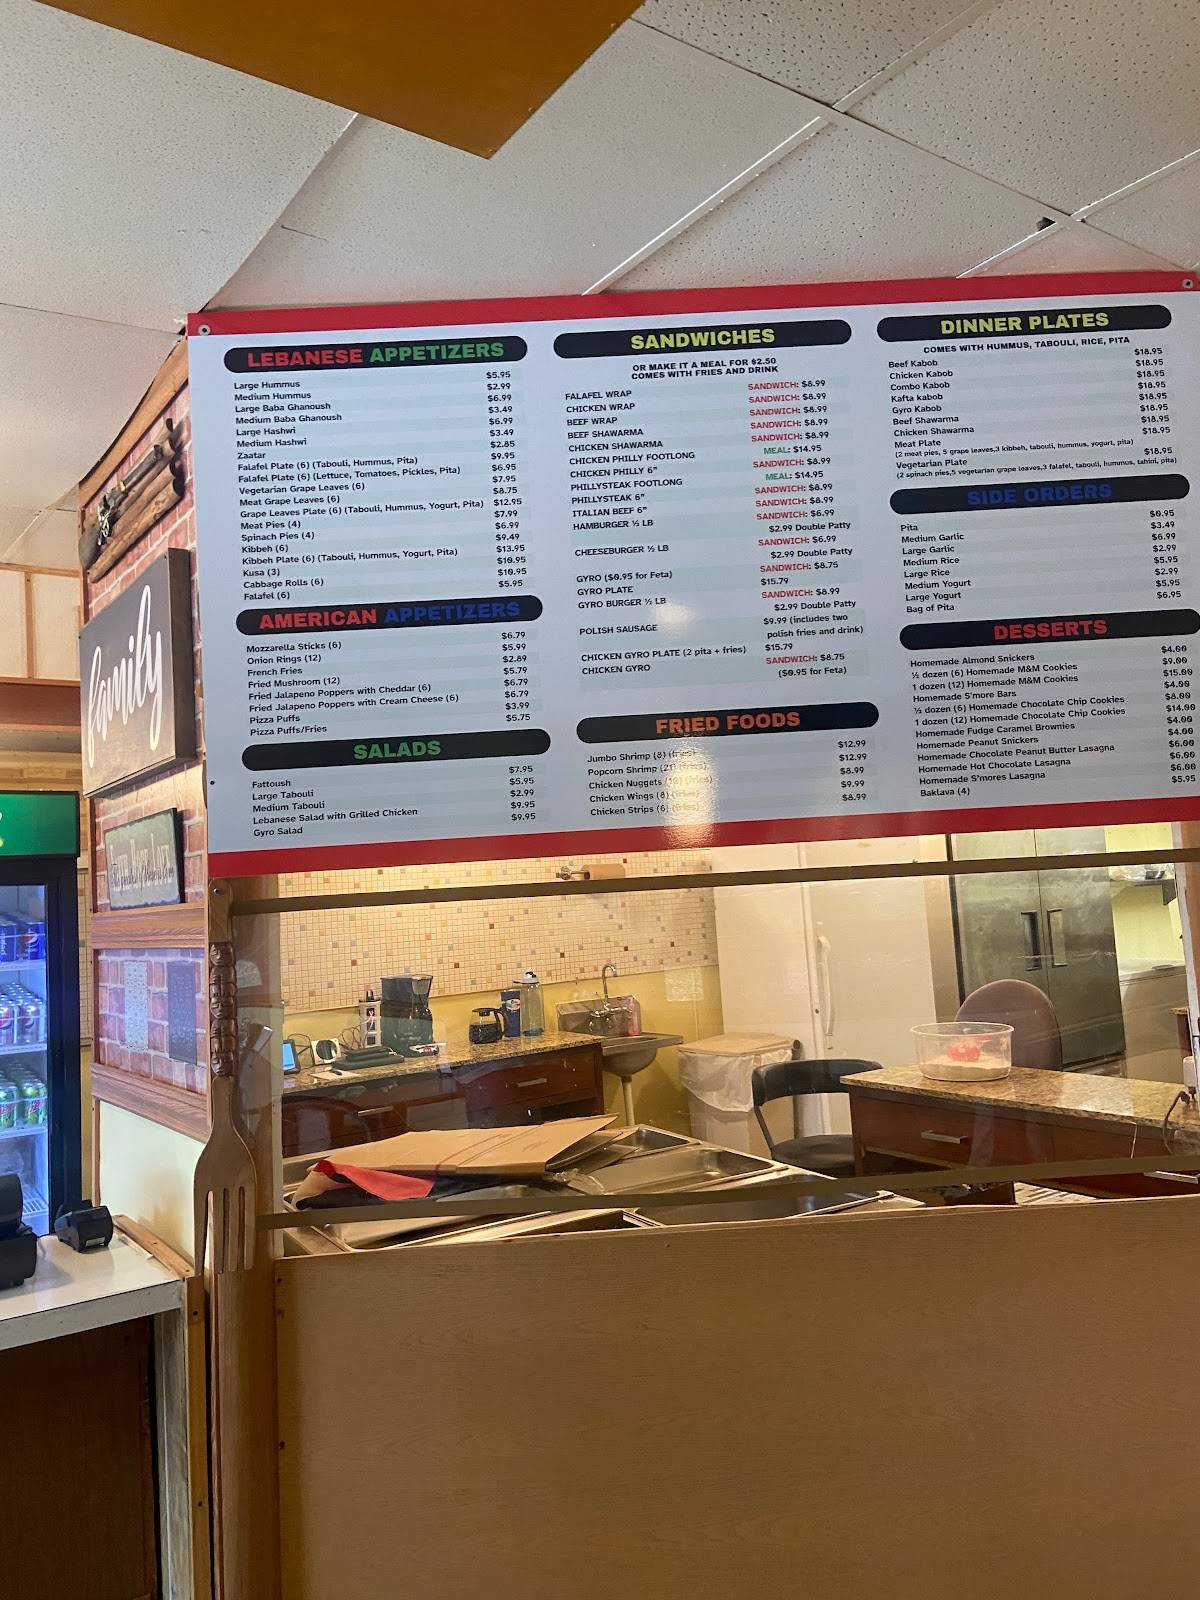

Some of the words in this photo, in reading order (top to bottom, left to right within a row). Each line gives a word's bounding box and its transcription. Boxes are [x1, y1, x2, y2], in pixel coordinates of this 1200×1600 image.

[940, 316, 1023, 334] DINNER
[1028, 311, 1109, 330] PLATES
[630, 328, 775, 350] SANDWICHES
[922, 344, 958, 355] COMES
[957, 343, 985, 352] WITH
[985, 340, 1033, 351] HUMMUS,
[1033, 337, 1079, 349] TABOULI,
[1079, 336, 1107, 346] RICE,
[1107, 335, 1131, 345] PITA
[246, 347, 363, 368] LEBANESE
[369, 341, 504, 362] APPETIZERS
[1132, 346, 1164, 357] $18.95
[631, 363, 647, 373] OR
[647, 361, 677, 372] MAKE
[677, 360, 689, 370] IT
[689, 360, 699, 369] A
[699, 359, 728, 369] MEAL
[727, 357, 749, 367] FOR
[749, 356, 777, 366] $2.50
[887, 358, 909, 369] Beef
[909, 358, 939, 368] Kabob
[484, 369, 512, 380] $5.95
[630, 370, 666, 381] COMES
[666, 369, 693, 379] WITH
[693, 367, 724, 377] FRIES
[723, 366, 746, 376] AND
[746, 364, 779, 374] DRINK
[232, 381, 260, 392] Large
[260, 380, 302, 389] Hummus
[746, 380, 800, 391] SANDWICH:
[563, 390, 604, 401] FALAFEL
[604, 388, 633, 399] WRAP
[486, 404, 513, 415] $3.49
[748, 406, 802, 417] SANDWICH:
[234, 414, 272, 425] Medium
[272, 414, 297, 424] Baba
[297, 412, 343, 423] Ghanoush
[565, 417, 590, 427] BEEF
[589, 415, 619, 426] WRAP
[749, 418, 803, 430] SANDWICH:
[1139, 413, 1170, 424] $18.95
[566, 430, 590, 440] BEEF
[590, 427, 645, 439] SHAWARMA
[892, 427, 929, 438] Chicken
[928, 425, 976, 436] Shawarma
[488, 439, 516, 450] $2.85
[762, 445, 791, 455] MEAL:
[791, 443, 823, 454] $14.95
[1142, 445, 1174, 457] $18.95
[235, 450, 267, 461] Zaatar
[489, 450, 516, 461] $9.95
[567, 454, 611, 466] CHICKEN
[610, 453, 644, 464] PHILLY
[645, 450, 696, 462] FOOTLONG
[236, 461, 269, 472] Falafel
[269, 461, 295, 471] Plate
[295, 460, 311, 471] (6)
[310, 457, 352, 470] (Tabouli,
[351, 458, 395, 467] Hummus,
[395, 455, 419, 466] Pita)
[894, 458, 943, 471] Vegetarian
[943, 457, 969, 467] Plate
[966, 488, 1016, 505] SIDE
[1023, 483, 1112, 502] ORDERS
[492, 508, 519, 519] $7.99
[239, 521, 264, 531] Meat
[264, 519, 286, 530] Pies
[286, 519, 302, 530] (4)
[493, 520, 520, 531] $6.99
[1149, 519, 1176, 531] $3.49
[239, 531, 278, 544] Spinach
[278, 530, 300, 541] Pies
[300, 530, 316, 541] (4)
[494, 531, 521, 542] $9.49
[900, 533, 937, 544] Medium
[937, 531, 965, 542] Garlic
[240, 543, 274, 554] Kibbeh
[273, 542, 289, 554] (6)
[496, 566, 528, 577] $10.95
[241, 579, 284, 590] Cabbage
[283, 577, 309, 588] Rolls
[309, 576, 325, 588] (6)
[759, 575, 790, 587] $15.79
[575, 586, 604, 597] GYRO
[603, 584, 634, 595] PLATE
[1155, 589, 1183, 600] $6.95
[905, 604, 924, 615] Bag
[924, 602, 935, 613] of
[935, 601, 956, 612] Pita
[258, 608, 377, 630] AMERICAN
[384, 601, 519, 622] APPETIZERS
[761, 615, 788, 626] $9.99
[788, 613, 831, 626] (includes
[830, 613, 849, 622] two
[500, 630, 527, 641] $6.79
[578, 625, 615, 636] POLISH
[614, 623, 658, 634] SAUSAGE
[765, 628, 795, 640] polish
[794, 626, 817, 637] fries
[817, 626, 836, 636] and
[835, 624, 864, 635] drink)
[993, 619, 1107, 640] DESSERTS
[244, 642, 296, 654] Mozzarella
[296, 640, 327, 651] Sticks
[327, 640, 342, 651] (6)
[500, 641, 527, 653] $5.99
[245, 654, 275, 666] Onion
[274, 653, 303, 665] Rings
[302, 652, 322, 664] (12)
[501, 653, 528, 664] $2.89
[909, 656, 960, 668] Homemade
[960, 654, 996, 665] Almond
[996, 652, 1036, 663] Snickers
[87, 584, 163, 769] family
[246, 667, 279, 678] French
[278, 665, 304, 676] Fries
[911, 682, 917, 692] 1
[917, 681, 946, 691] dozen
[946, 679, 966, 691] (12)
[965, 677, 1017, 689] Homemade
[1017, 675, 1042, 686] M&M
[1042, 673, 1079, 684] Cookies
[504, 712, 532, 723] $5.75
[655, 715, 720, 735] FRIED
[726, 711, 800, 730] FOODS
[248, 726, 275, 737] Pizza
[275, 723, 328, 736] Puffs/Fries
[353, 739, 441, 760] SALADS
[836, 738, 867, 749] $12.99
[586, 753, 618, 764] Jumbo
[617, 750, 652, 762] Shrimp
[507, 764, 534, 775] $7.95
[250, 778, 292, 790] Fattoush
[839, 778, 866, 789] $9.99
[588, 792, 625, 803] Chicken
[625, 790, 653, 802] Wings
[919, 787, 956, 798] Baklava
[955, 785, 971, 797] (4)
[509, 799, 536, 810] $9.95
[251, 815, 297, 826] Lebanese
[297, 812, 325, 822] Salad
[325, 810, 347, 821] with
[347, 808, 381, 820] Grilled
[380, 807, 419, 818] Chicken
